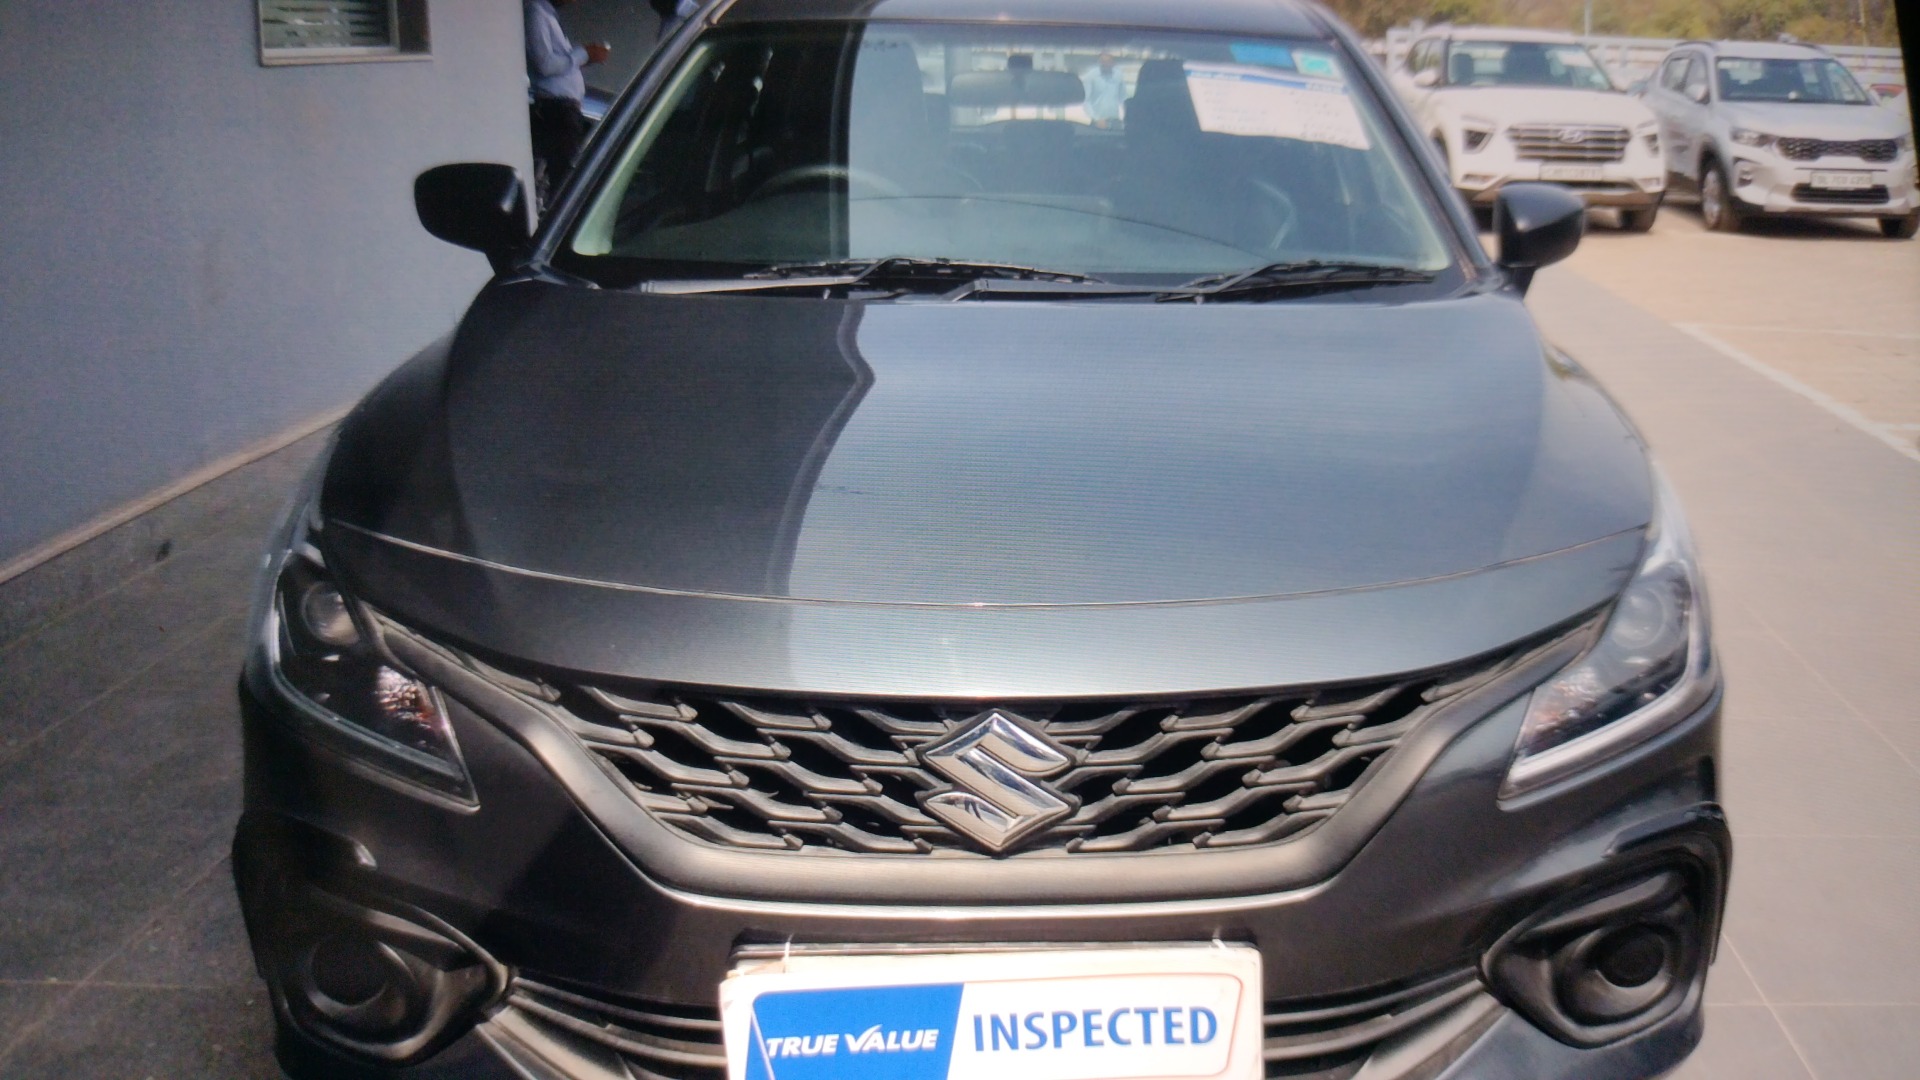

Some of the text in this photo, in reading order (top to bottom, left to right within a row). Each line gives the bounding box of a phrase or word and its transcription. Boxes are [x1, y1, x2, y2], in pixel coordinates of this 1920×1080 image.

[767, 1023, 939, 1058] TRUE VALUE
[973, 1007, 1217, 1052] INSPECTED
